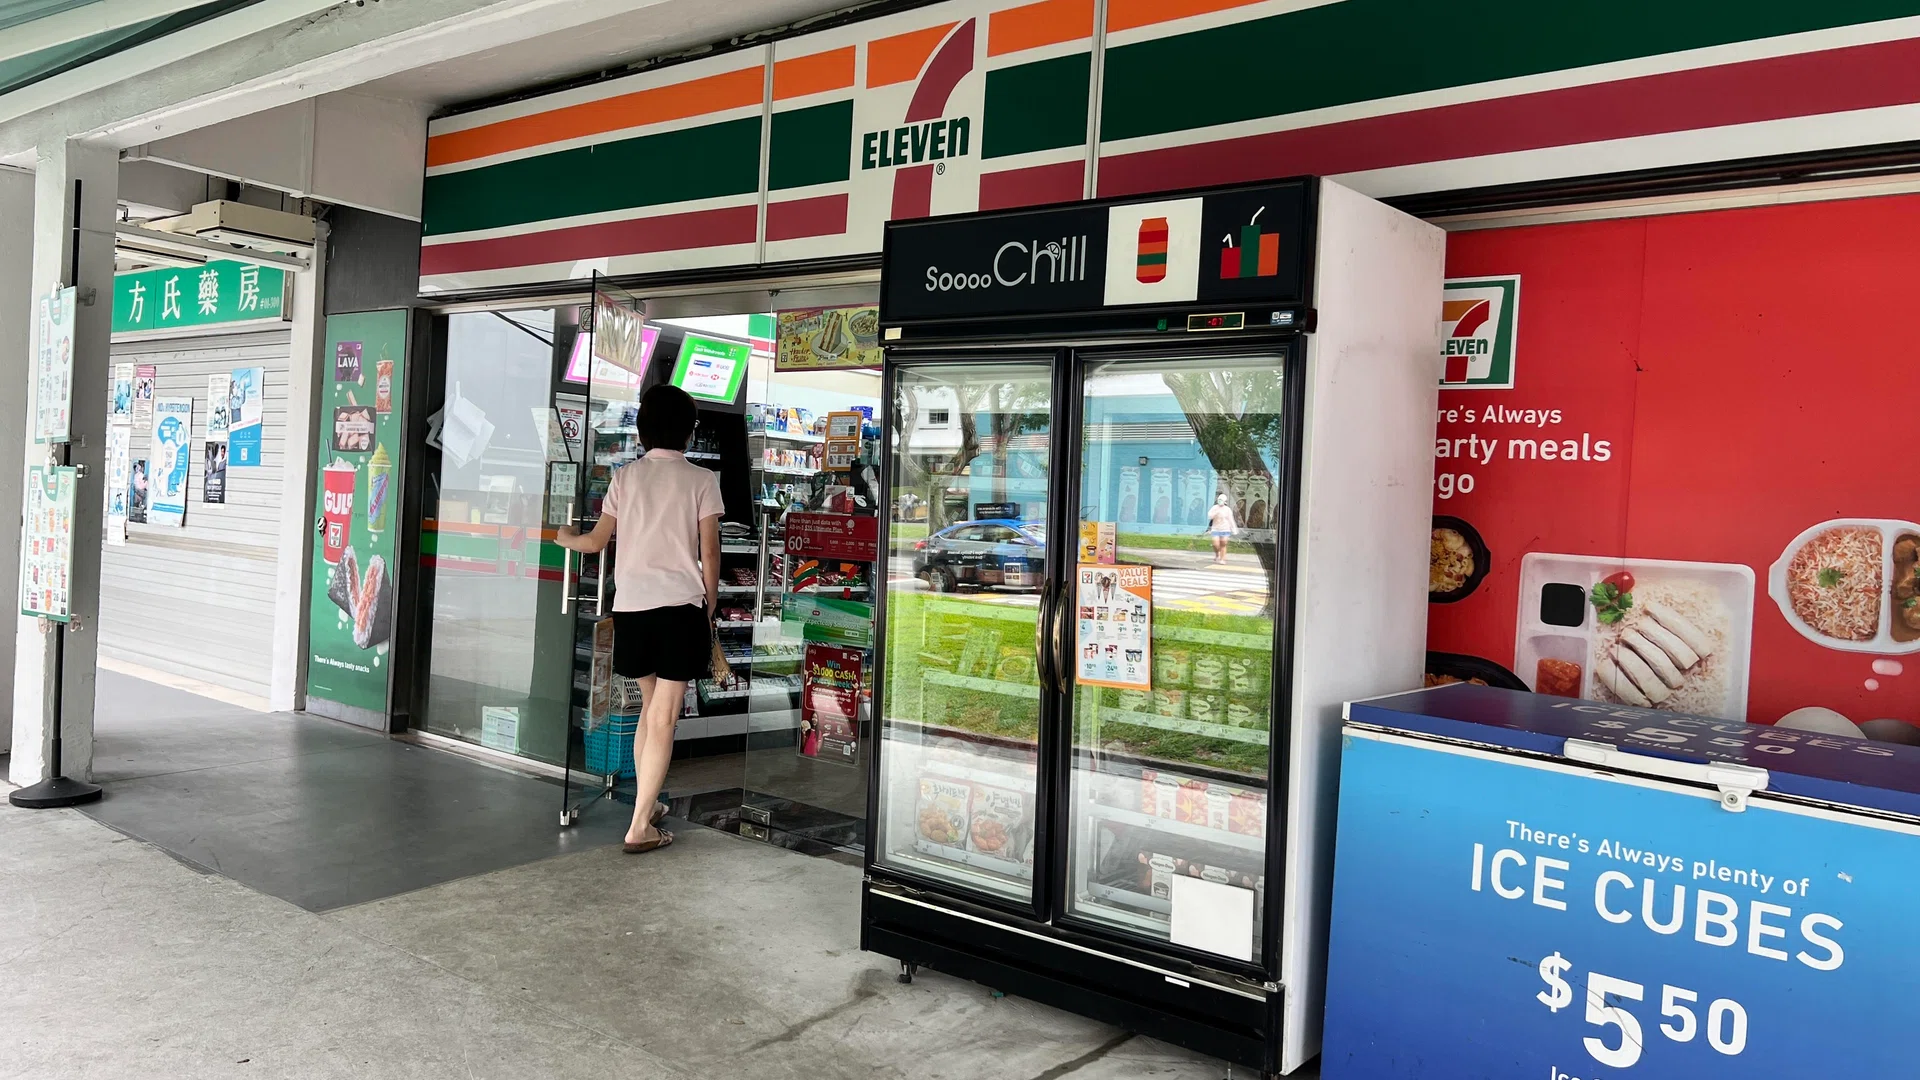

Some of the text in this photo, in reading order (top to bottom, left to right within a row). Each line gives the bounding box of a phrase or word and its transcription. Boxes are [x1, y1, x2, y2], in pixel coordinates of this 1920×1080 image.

[890, 17, 976, 221] 7
[128, 264, 260, 324] 方氏藥房
[337, 357, 359, 368] LAVA
[1481, 404, 1562, 428] Always
[1507, 432, 1611, 462] meals
[788, 536, 803, 551] 60
[1120, 567, 1148, 577] VALUE
[1120, 577, 1148, 587] DEALS
[330, 658, 344, 669] Always
[344, 661, 355, 671] tasty
[355, 664, 370, 673] snacks
[812, 665, 854, 681] $1000 CASH
[826, 660, 840, 669] Win
[1551, 703, 1896, 757] ICE CUBES
[1584, 732, 1616, 740] Ice
[1623, 738, 1696, 753] Cubes
[1506, 819, 1809, 897] There's Always plenty of
[1471, 843, 1845, 971] ICE CUBES
[1550, 1066, 1581, 1080] Ic
